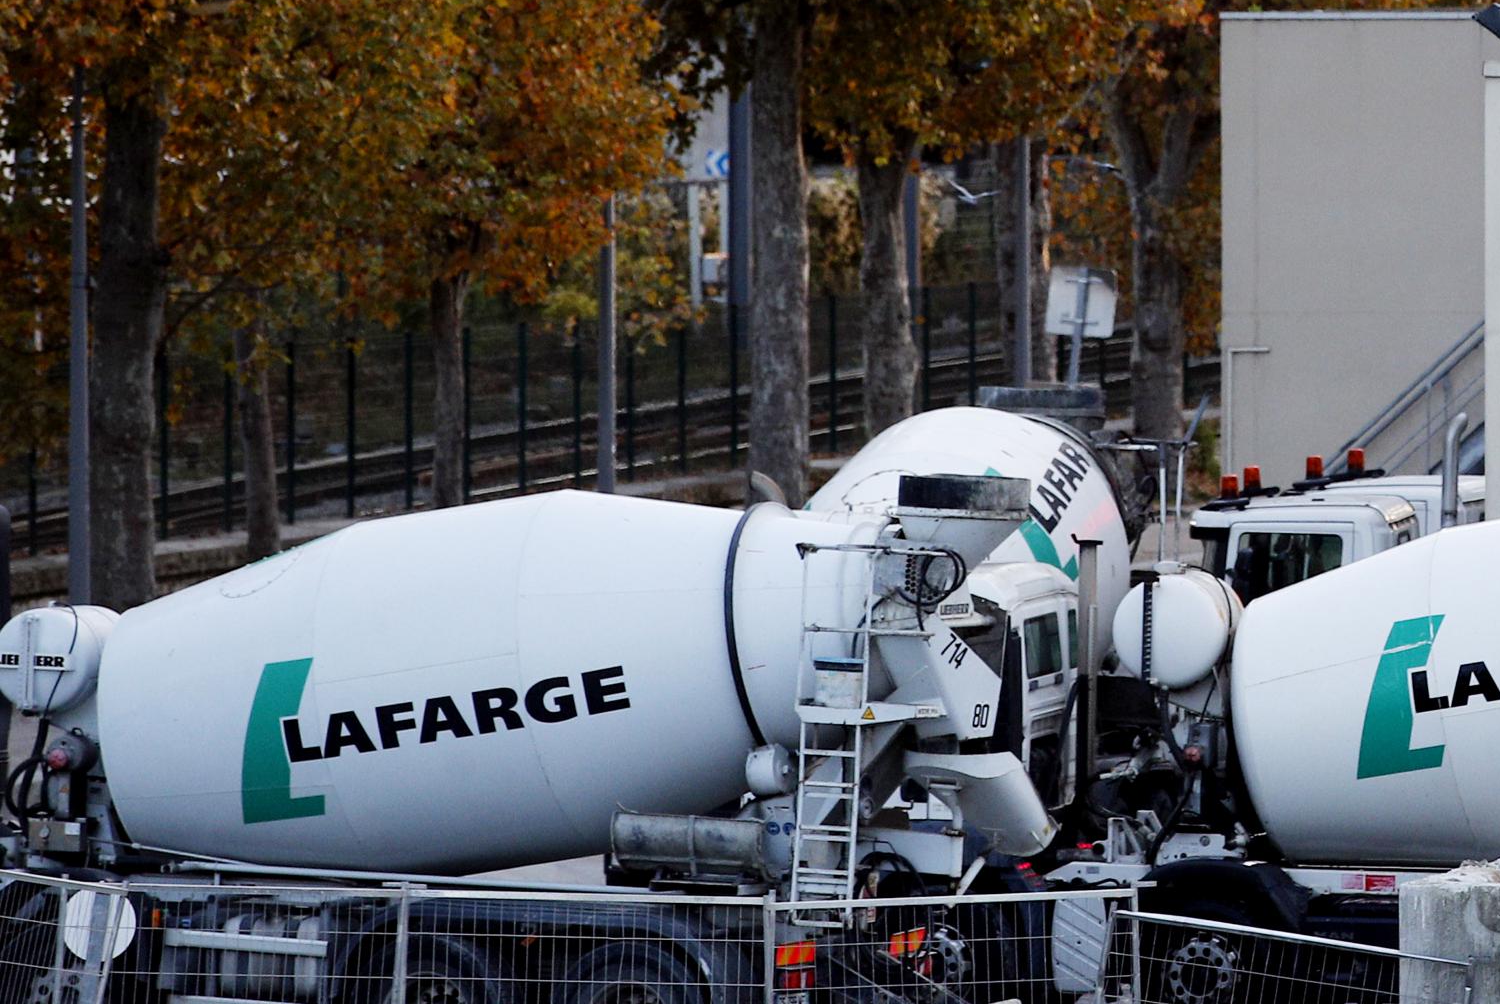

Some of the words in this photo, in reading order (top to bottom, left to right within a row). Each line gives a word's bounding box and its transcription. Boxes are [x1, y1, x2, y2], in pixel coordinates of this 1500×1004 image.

[940, 632, 968, 670] 714
[282, 665, 631, 763] LAFARGE
[972, 703, 990, 729] 80
